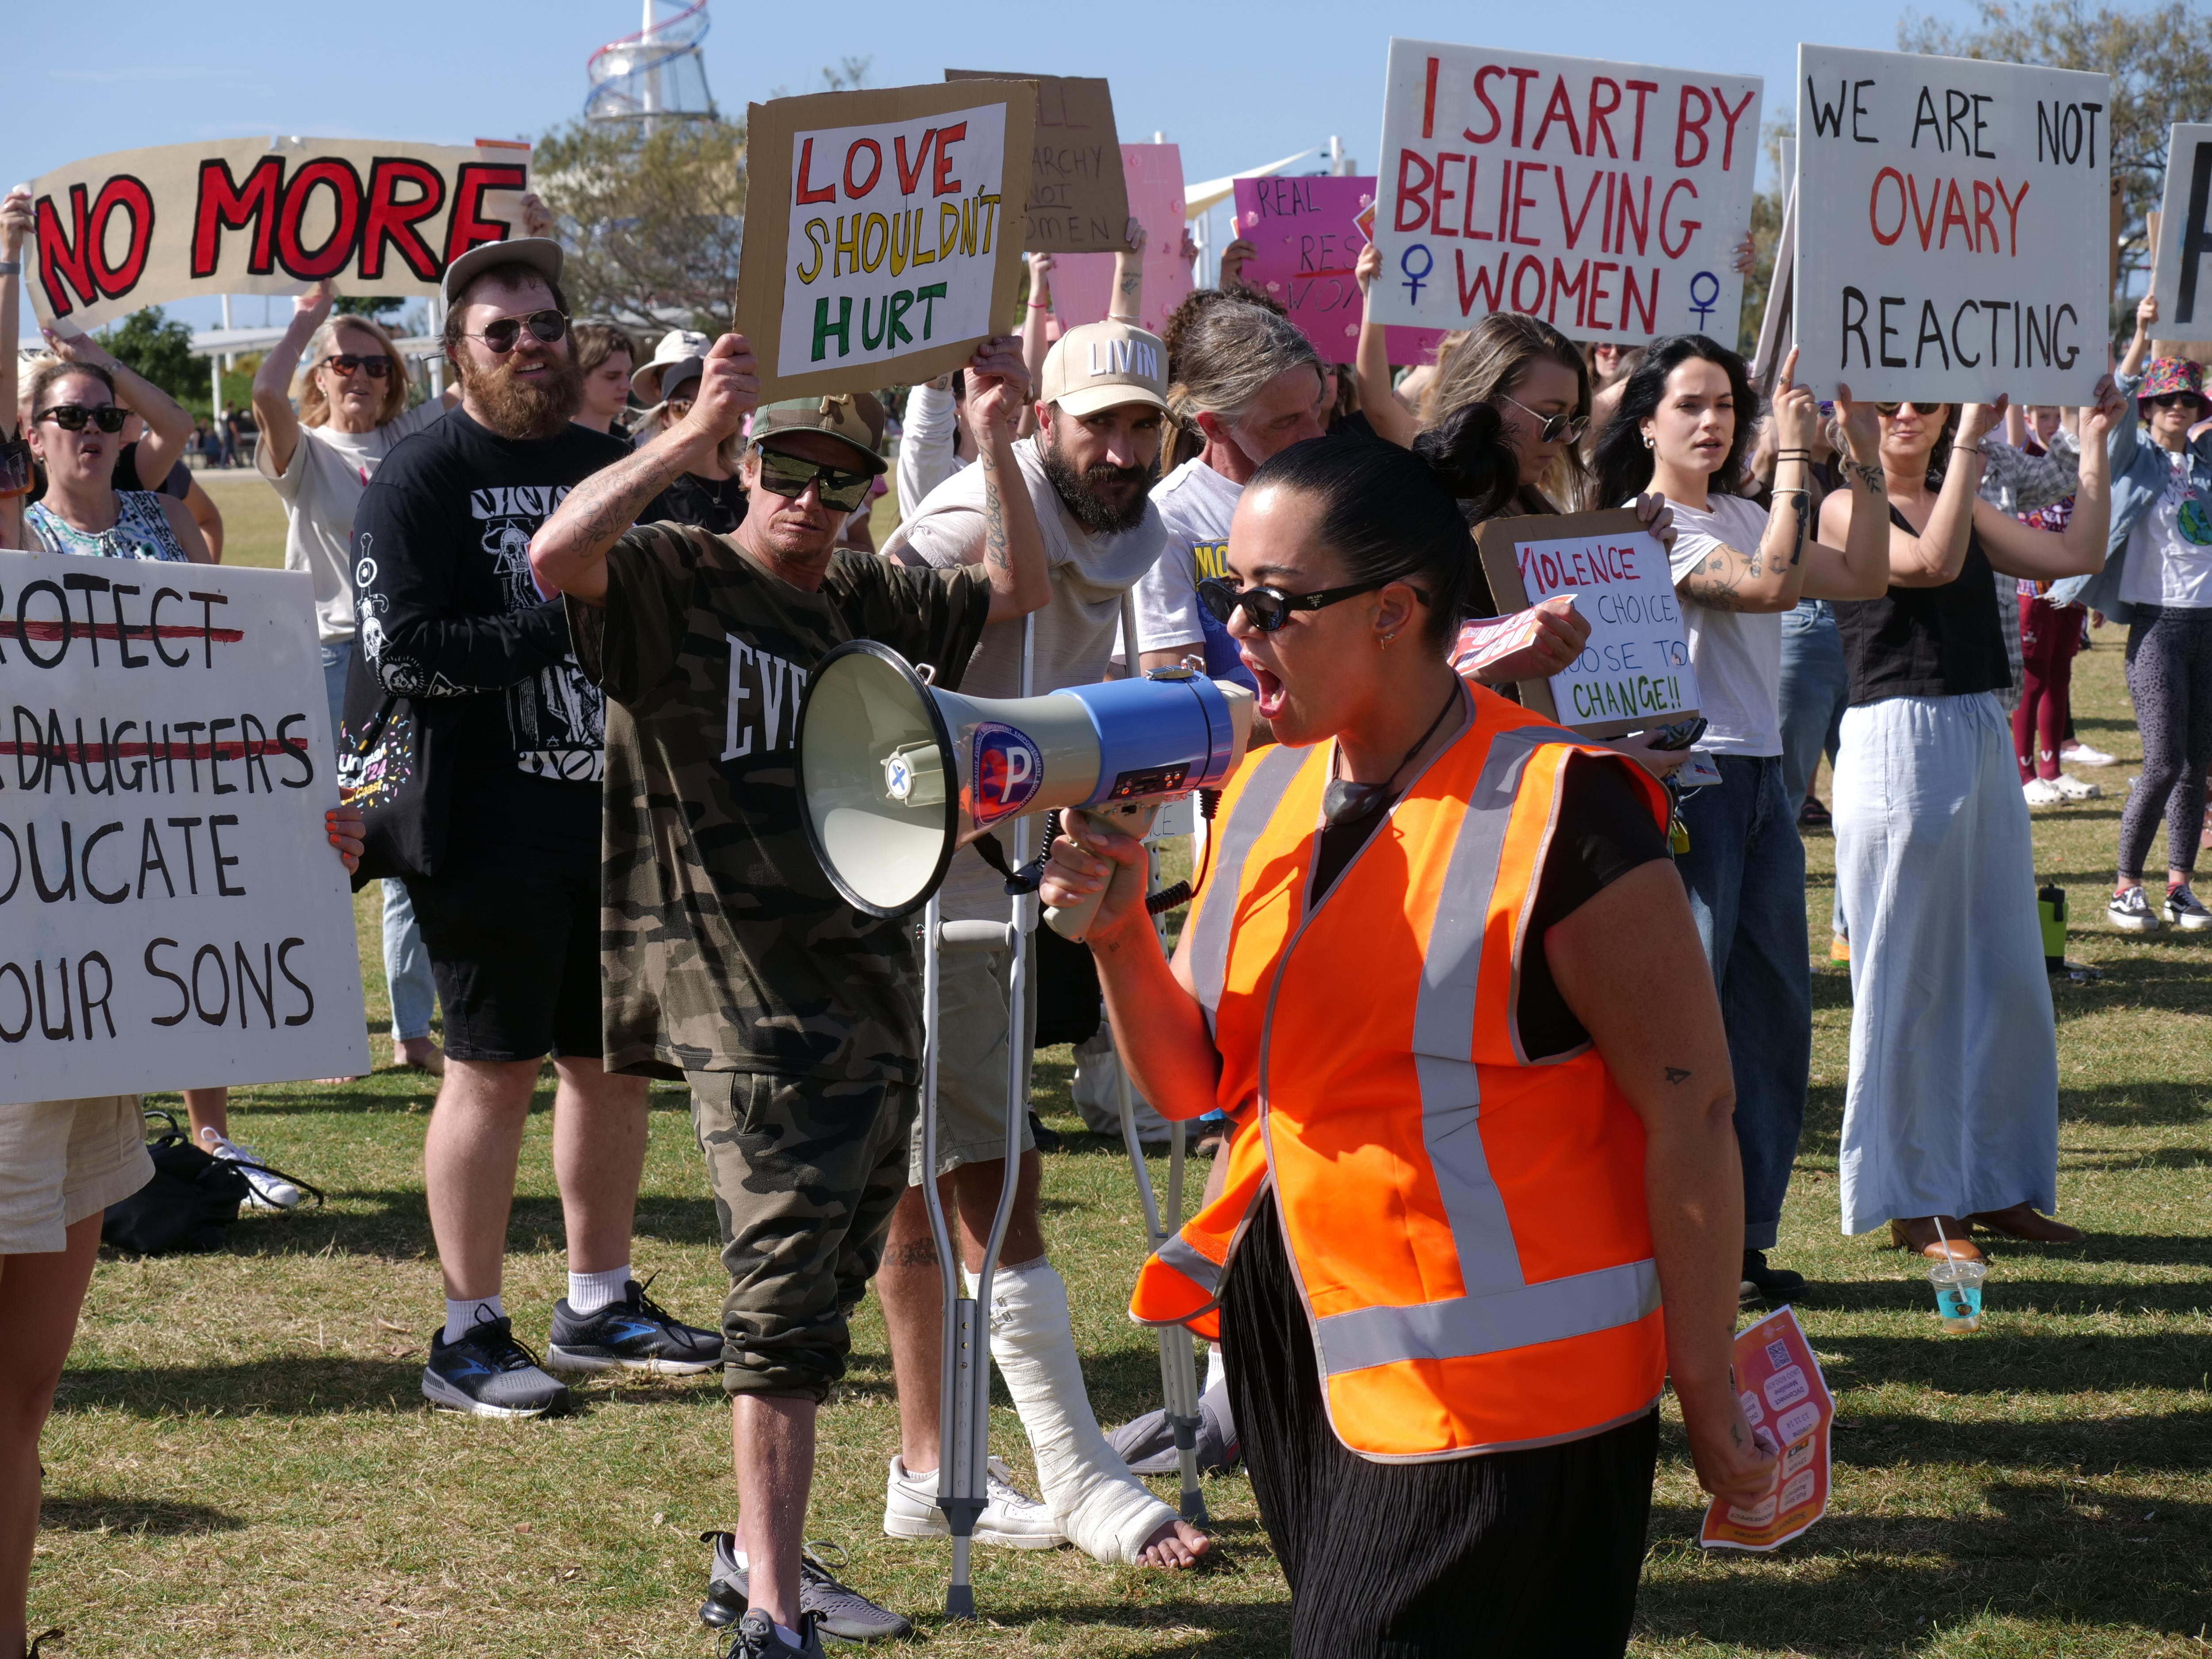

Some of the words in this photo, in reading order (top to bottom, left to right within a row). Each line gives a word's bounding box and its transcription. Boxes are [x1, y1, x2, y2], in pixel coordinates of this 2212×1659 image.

[1422, 57, 1439, 138] I
[1463, 65, 1658, 162] START
[1674, 84, 1755, 171] BY
[1808, 74, 1879, 143] WE
[1912, 89, 1997, 158] ARE
[2038, 100, 2102, 169] NOT
[796, 120, 967, 206] LOVE
[1257, 179, 1322, 218] REAL
[1394, 148, 1702, 260] BELIEVING
[35, 174, 155, 319] NO
[796, 184, 1001, 285] SHOULDN'T
[1869, 166, 2030, 257] OVARY
[811, 281, 947, 362] HURT
[1455, 249, 1660, 335] WOMEN
[1841, 285, 2080, 371] REACTING
[1088, 339, 1158, 382] LIVIN
[1516, 544, 1640, 595] VIOLENCE
[1598, 593, 1678, 625] CHOICE,
[0, 573, 228, 669] OTECT
[1653, 641, 1688, 666] TO
[1573, 675, 1681, 718] CHANGE!!
[14, 705, 314, 795] DAUGHTERS
[1014, 730, 1041, 779] EMPOWERMENT
[144, 937, 314, 1029] SONS
[1774, 1379, 1799, 1395] Mensline
[1775, 1386, 1805, 1405] DVConnect
